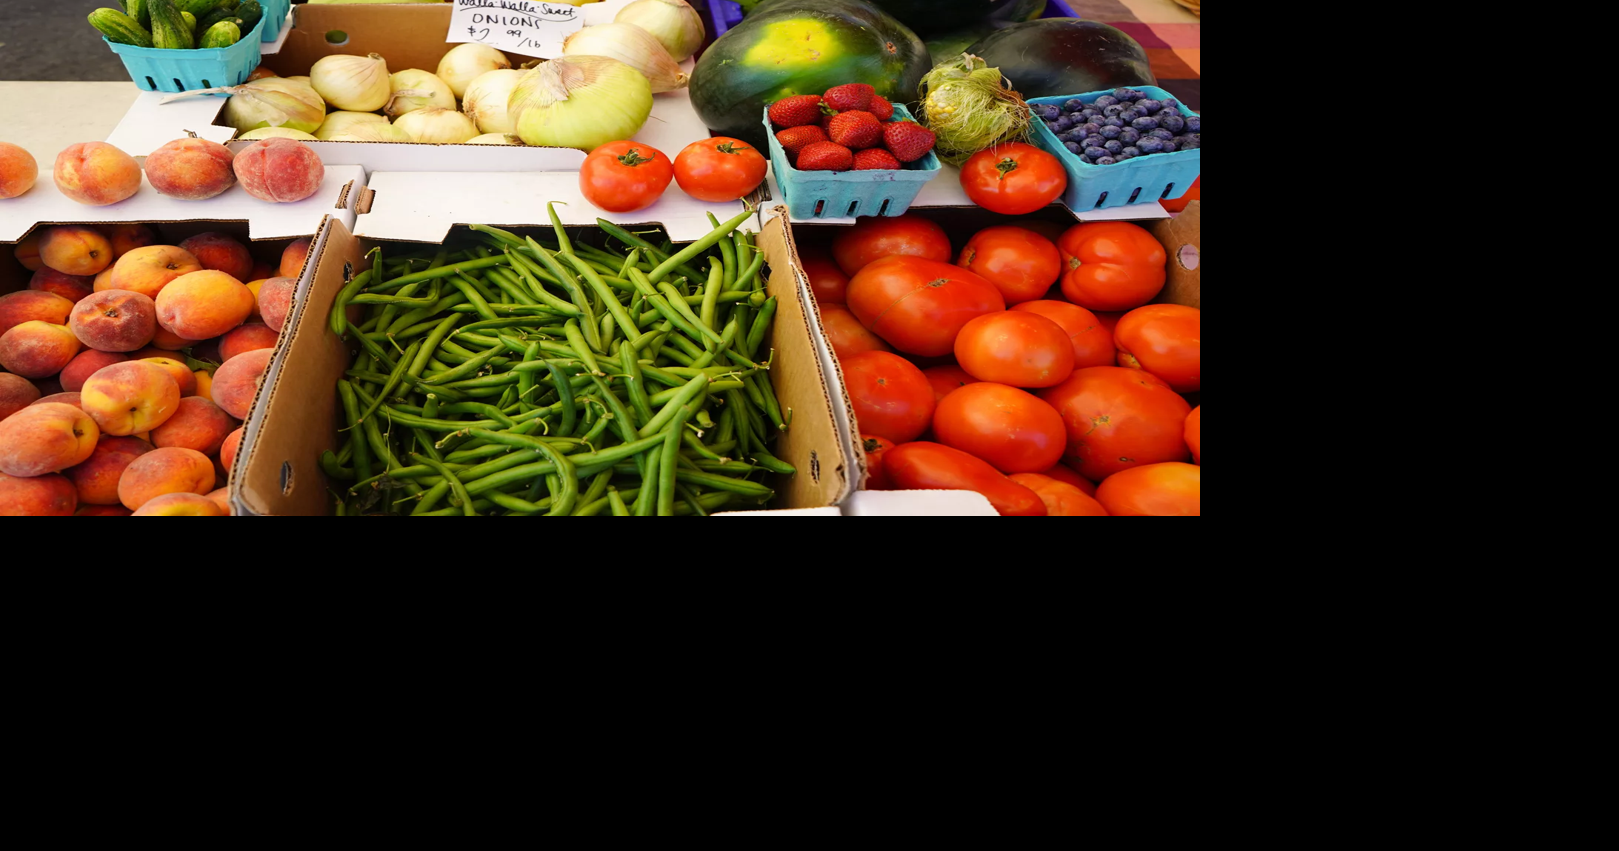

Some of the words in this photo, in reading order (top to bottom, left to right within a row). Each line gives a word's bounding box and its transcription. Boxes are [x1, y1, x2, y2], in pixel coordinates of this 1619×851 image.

[472, 13, 542, 30] ONIONS
[506, 29, 522, 38] 99
[517, 37, 541, 48] /lb
